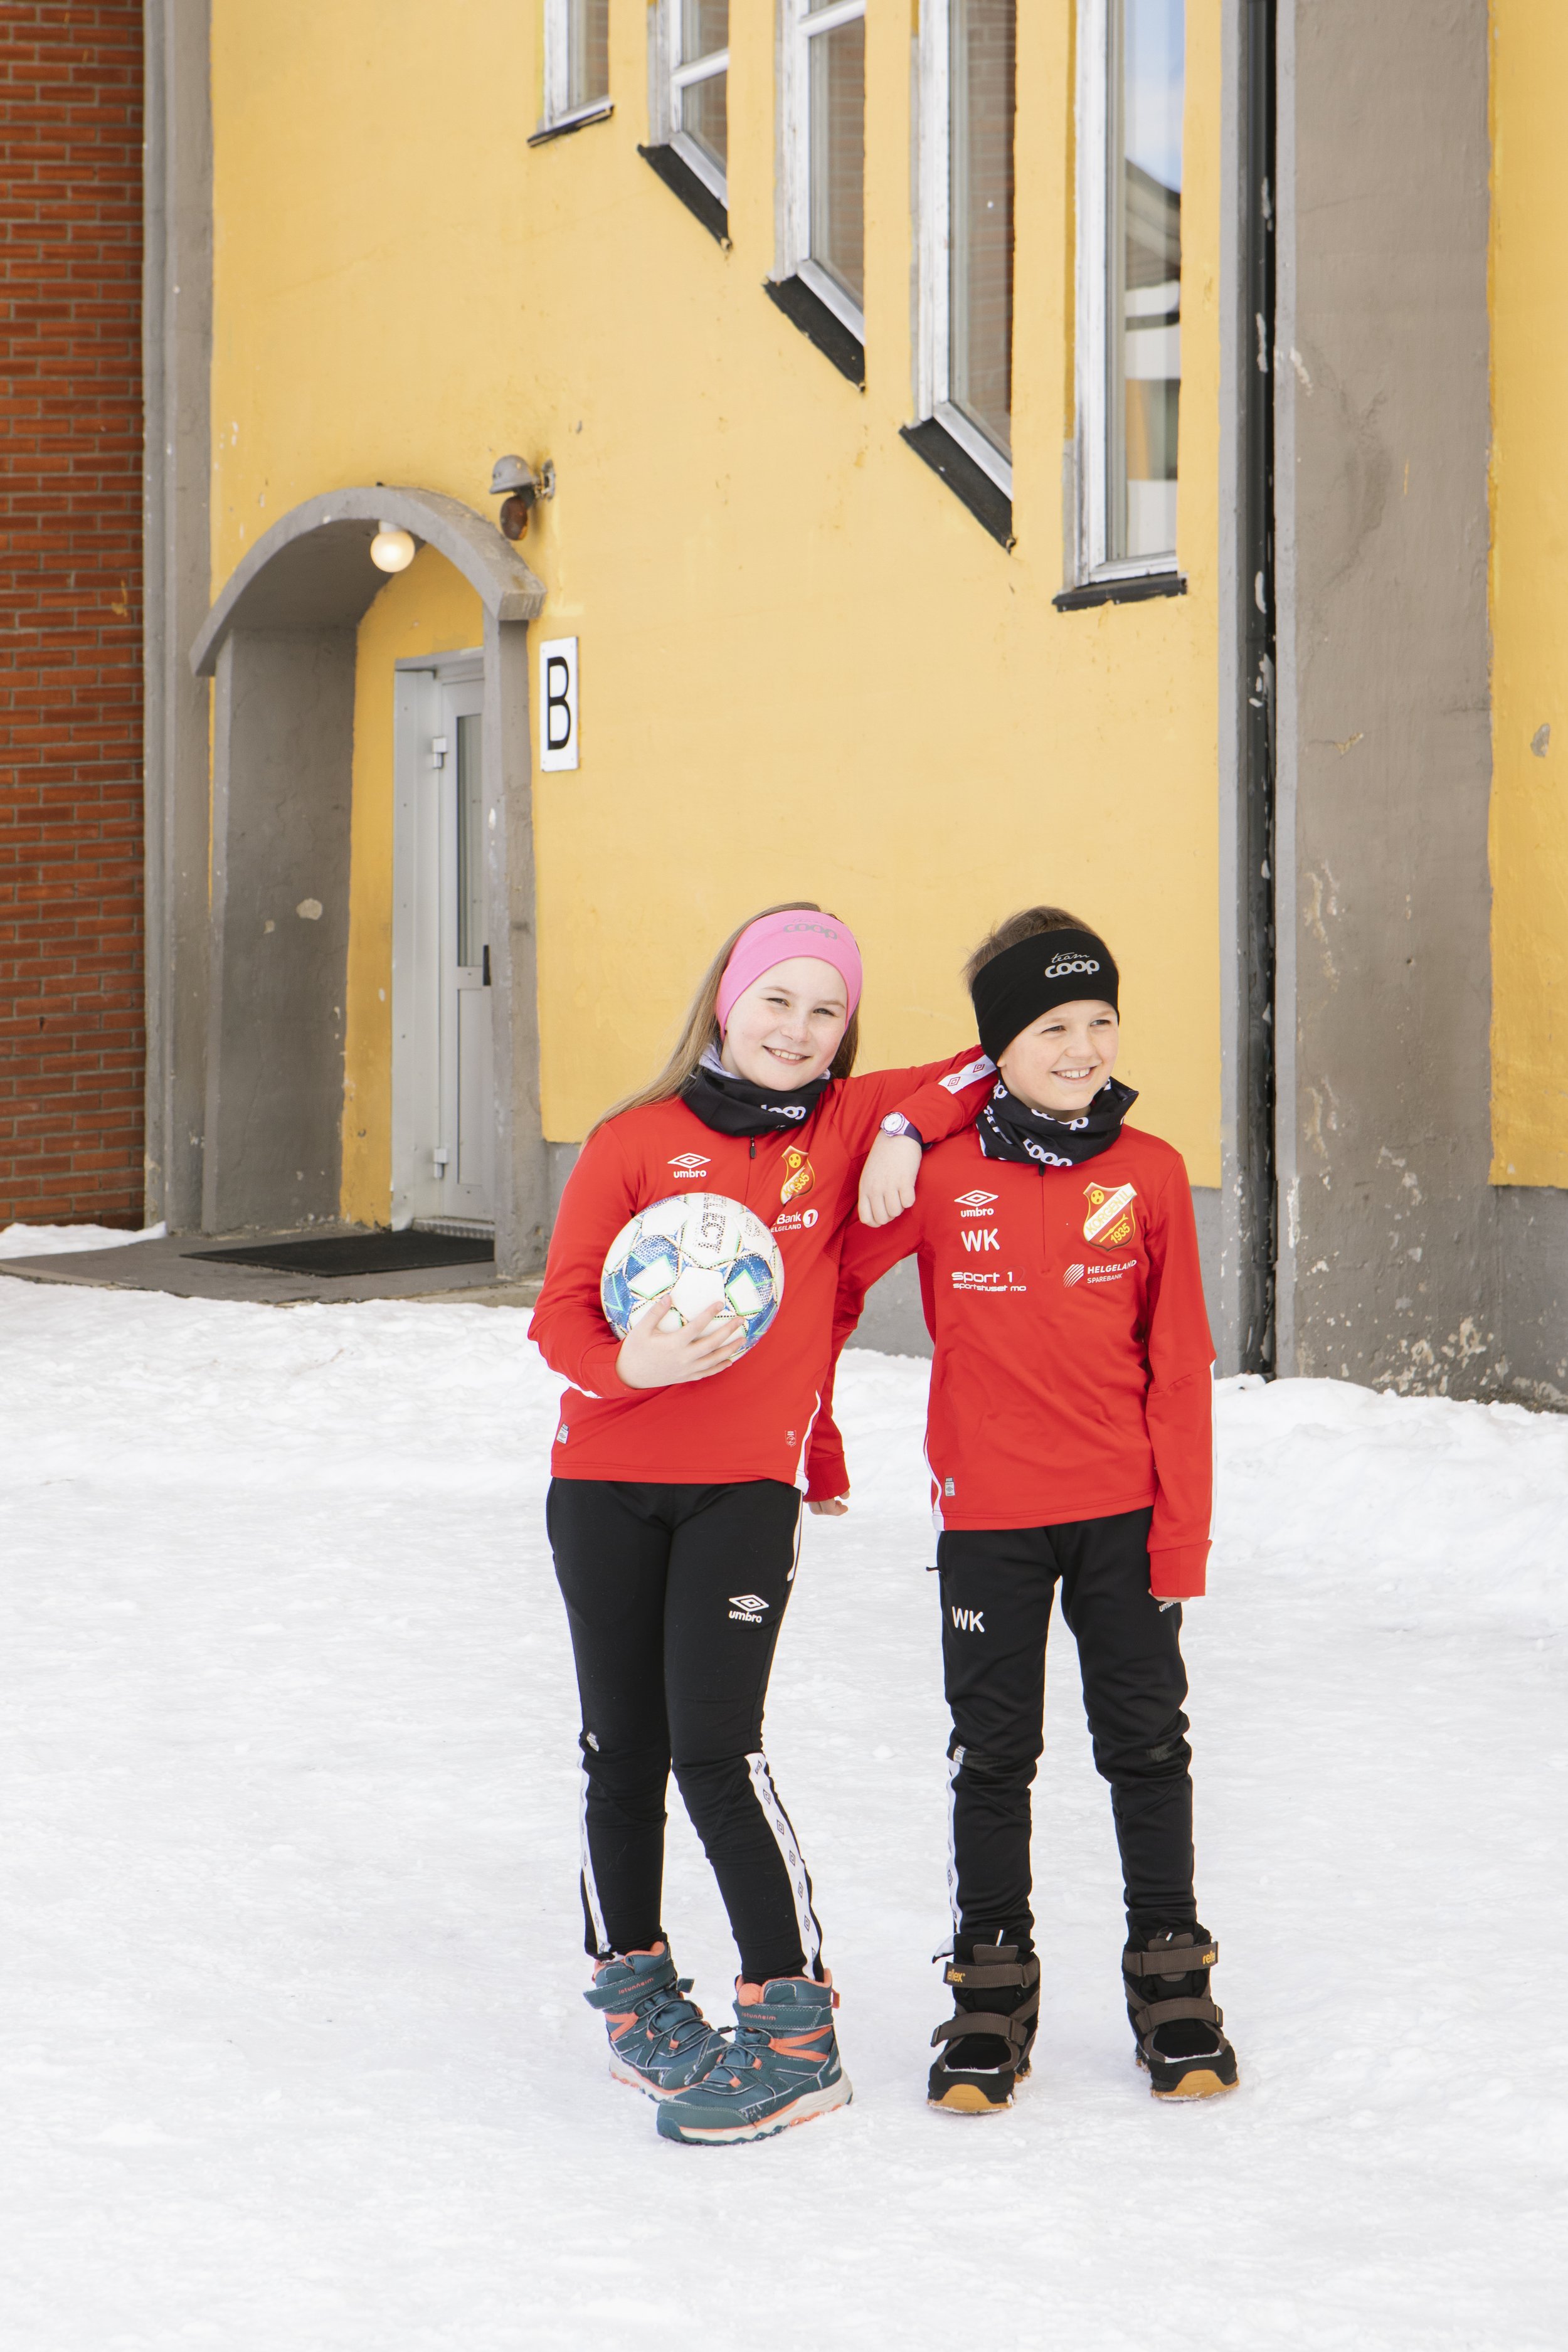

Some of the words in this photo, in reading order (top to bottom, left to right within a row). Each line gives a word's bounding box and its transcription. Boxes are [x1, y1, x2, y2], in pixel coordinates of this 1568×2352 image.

[547, 656, 571, 750] B
[783, 923, 837, 940] coop
[1051, 952, 1089, 963] team
[1044, 960, 1100, 978] coop
[673, 1168, 707, 1179] umbro
[776, 1211, 802, 1225] Bank
[960, 1207, 994, 1218] umbro
[1086, 1199, 1123, 1235] KORGEN
[770, 1223, 802, 1233] ELGELAND
[1111, 1222, 1131, 1244] 1935
[961, 1227, 1000, 1252] WK
[1087, 1259, 1136, 1274] HELGELAND
[951, 1272, 1000, 1283] sport
[1007, 1271, 1013, 1283] 1
[1087, 1273, 1123, 1284] SPAREBANK
[953, 1283, 1008, 1291] sportshuset
[728, 1611, 763, 1623] umbro
[951, 1606, 985, 1633] WK
